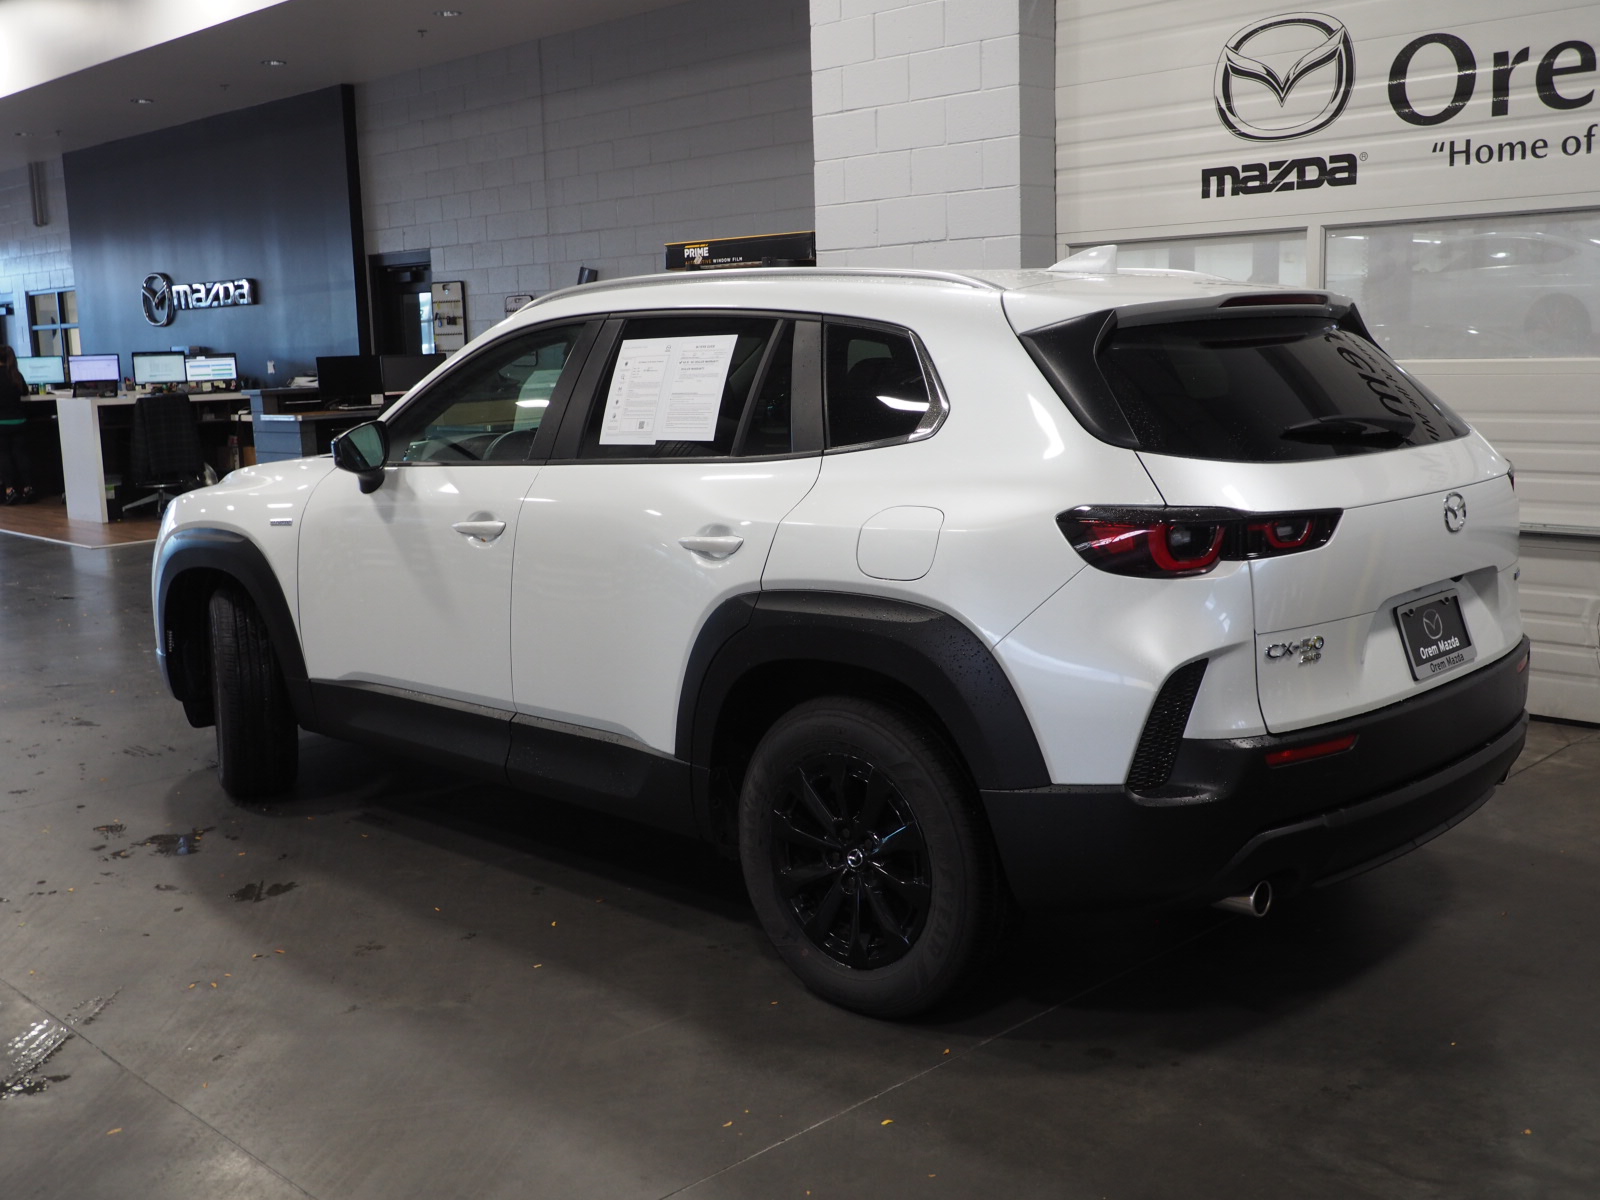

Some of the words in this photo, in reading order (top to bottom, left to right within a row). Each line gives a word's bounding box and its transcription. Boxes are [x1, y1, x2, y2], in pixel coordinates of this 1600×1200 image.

[1387, 32, 1597, 126] Ore
[1561, 123, 1599, 156] of
[684, 247, 709, 258] PRIME
[1419, 644, 1439, 660] Orem
[1438, 635, 1460, 653] Mazda
[1429, 661, 1447, 673] Orem
[1445, 653, 1465, 666] Mazda
